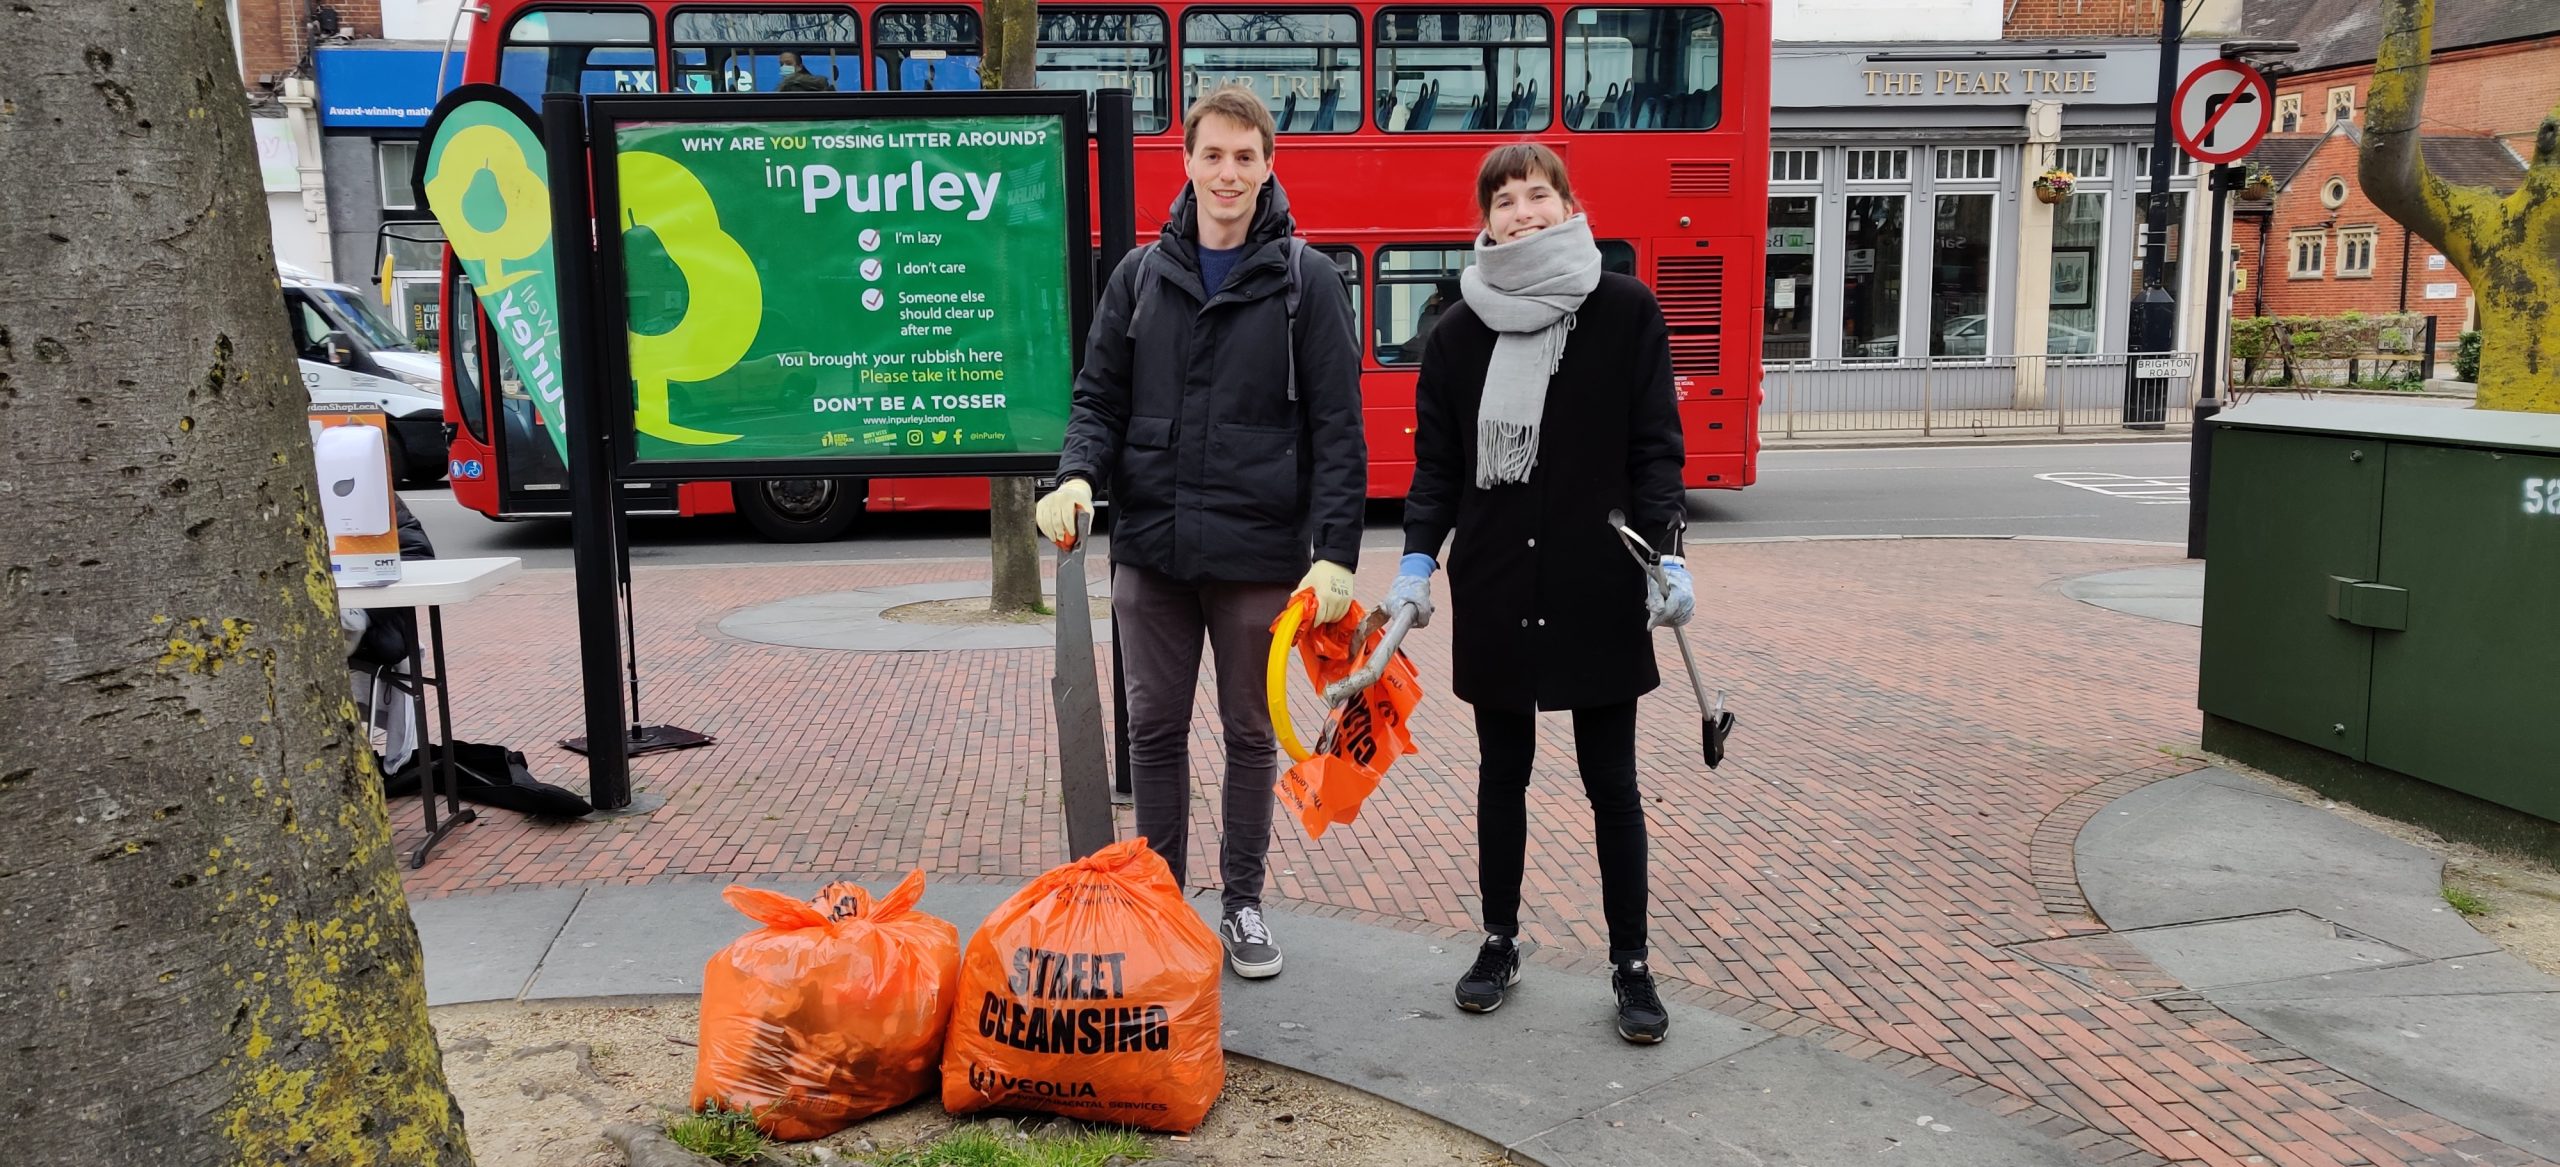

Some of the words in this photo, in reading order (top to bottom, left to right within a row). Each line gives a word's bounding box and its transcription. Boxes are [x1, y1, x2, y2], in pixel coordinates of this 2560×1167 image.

[1935, 69, 2012, 94] PEAR
[2020, 68, 2098, 93] TREE
[329, 106, 404, 118] Award-winning
[682, 138, 724, 151] WHY
[730, 137, 765, 150] ARE
[770, 136, 807, 149] YOU
[812, 134, 885, 149] TOSSING
[888, 133, 951, 148] LITTER
[957, 131, 1047, 147] AROUND?
[765, 158, 796, 187] in
[802, 160, 1002, 221] Purley
[918, 231, 942, 246] lazy
[904, 262, 936, 274] don't
[939, 264, 966, 274] care
[898, 291, 958, 304] Someone
[960, 290, 985, 302] else
[900, 307, 942, 320] should
[945, 307, 974, 319] clear
[977, 309, 994, 321] up
[900, 324, 929, 336] after
[932, 326, 952, 334] me
[776, 353, 803, 366] You
[809, 352, 868, 369] brought
[873, 353, 905, 368] your
[911, 350, 965, 364] rubbish
[968, 348, 1003, 362] here
[2138, 360, 2191, 369] BRIGHTON
[860, 369, 909, 384] Please
[911, 368, 943, 382] take
[946, 368, 957, 382] it
[960, 368, 1004, 381] home
[2149, 368, 2178, 377] ROAD
[813, 397, 874, 412] DON'T
[880, 396, 906, 410] BE
[911, 396, 926, 410] A
[931, 394, 1006, 409] TOSSER
[863, 415, 956, 425] www.inpurley.london
[1009, 946, 1126, 1000] STREET
[978, 991, 1169, 1055] CLEANSING
[1001, 1073, 1097, 1098] VEOLIA
[1108, 1100, 1168, 1112] SERVICES
